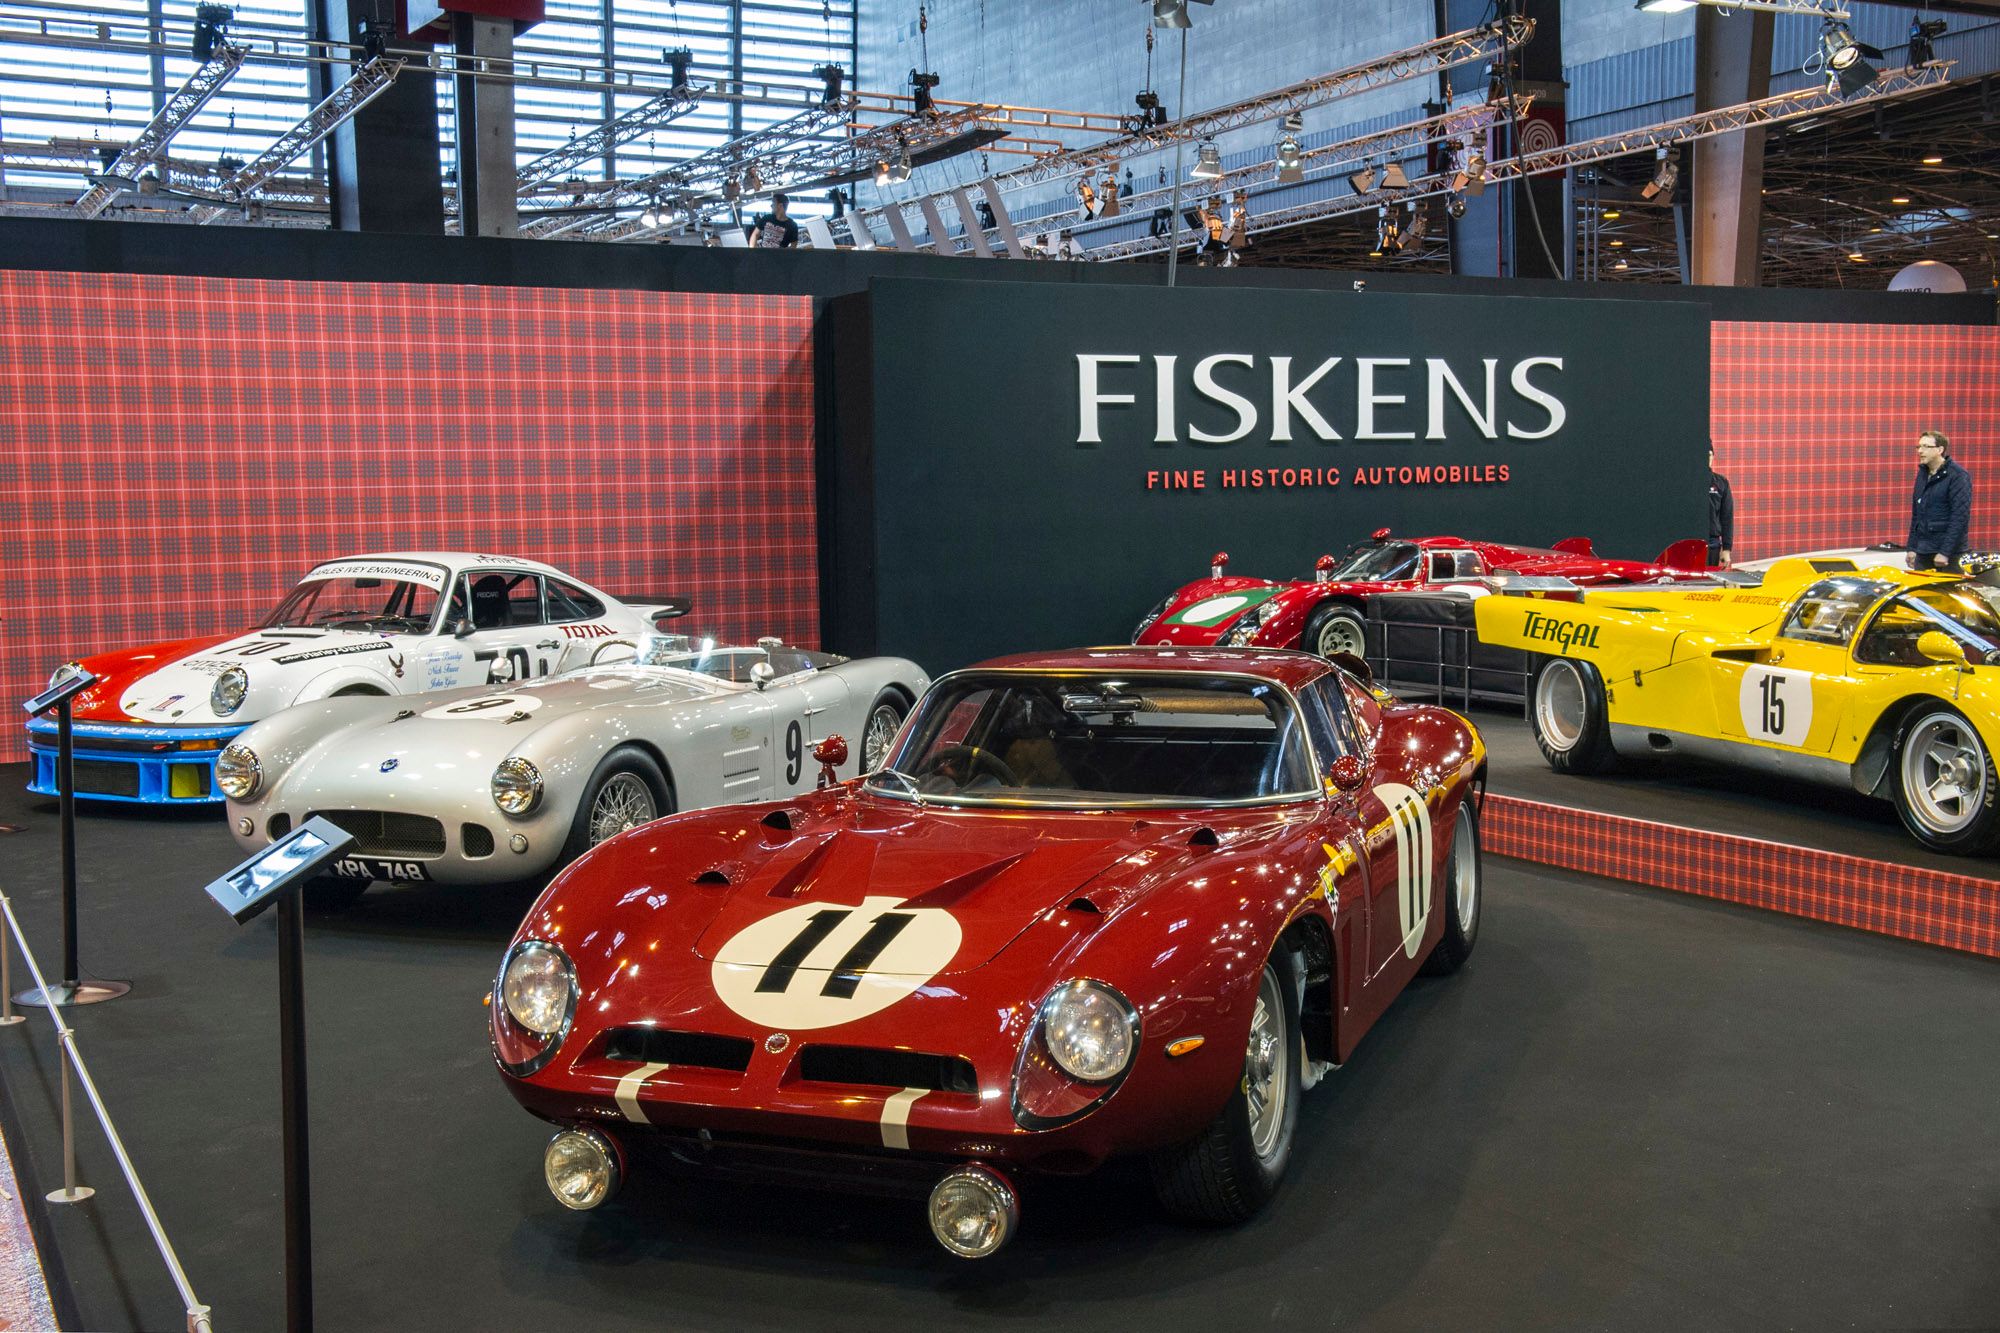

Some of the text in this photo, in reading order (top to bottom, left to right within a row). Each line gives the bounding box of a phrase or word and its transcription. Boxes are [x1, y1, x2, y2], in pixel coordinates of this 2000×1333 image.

[1076, 353, 1567, 443] FISKENS
[1147, 464, 1511, 489] FINE HISTORIC AUTOMOBILES
[344, 566, 367, 574] IVEY
[366, 566, 441, 583] ENGINEERING
[213, 641, 291, 656] 70
[558, 624, 618, 639] TOTAL
[1523, 610, 1600, 655] TERGAL
[474, 646, 531, 685] 70
[446, 698, 516, 714] 9
[1759, 673, 1787, 735] 15
[785, 719, 802, 786] 9
[378, 861, 425, 881] 748
[1394, 795, 1424, 932] 11
[754, 909, 918, 1000] 11
